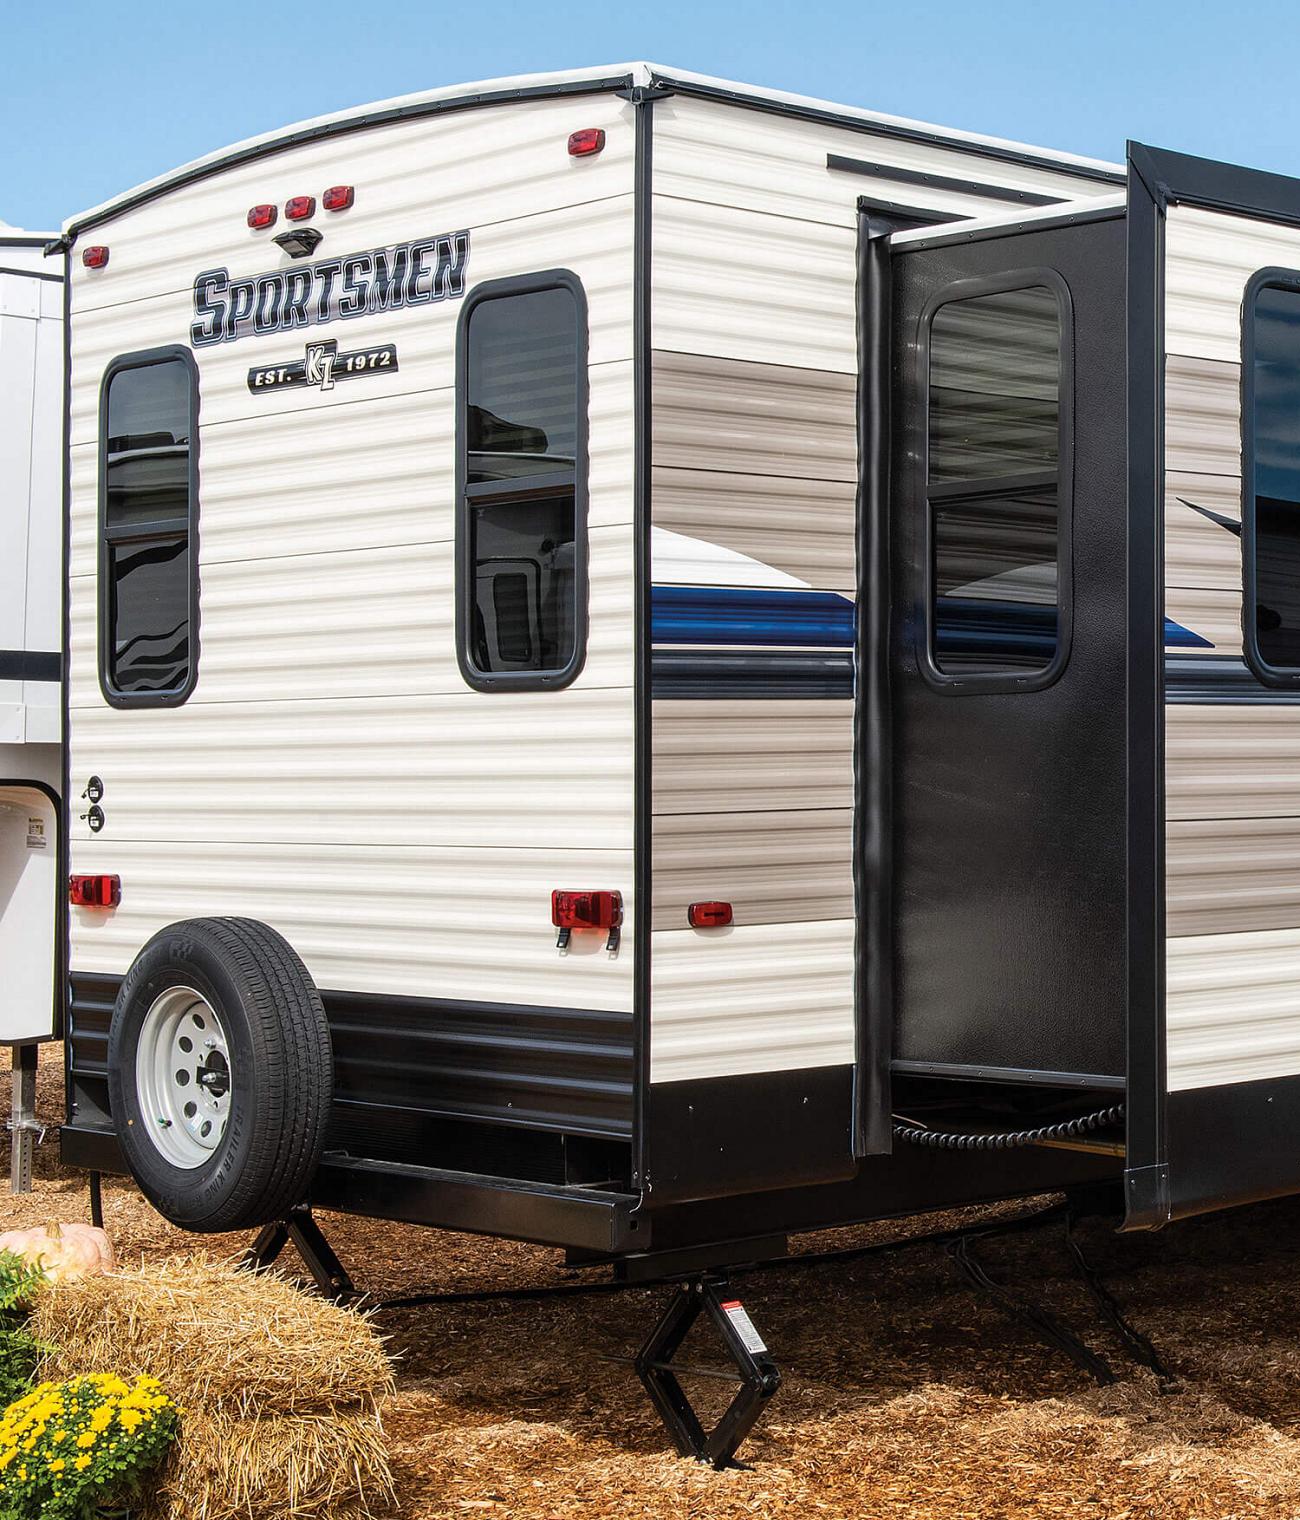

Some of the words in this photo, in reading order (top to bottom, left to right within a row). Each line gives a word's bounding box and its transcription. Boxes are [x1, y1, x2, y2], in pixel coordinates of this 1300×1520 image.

[254, 368, 292, 387] EST.
[345, 351, 391, 372] 1972
[204, 1170, 226, 1202] KING
